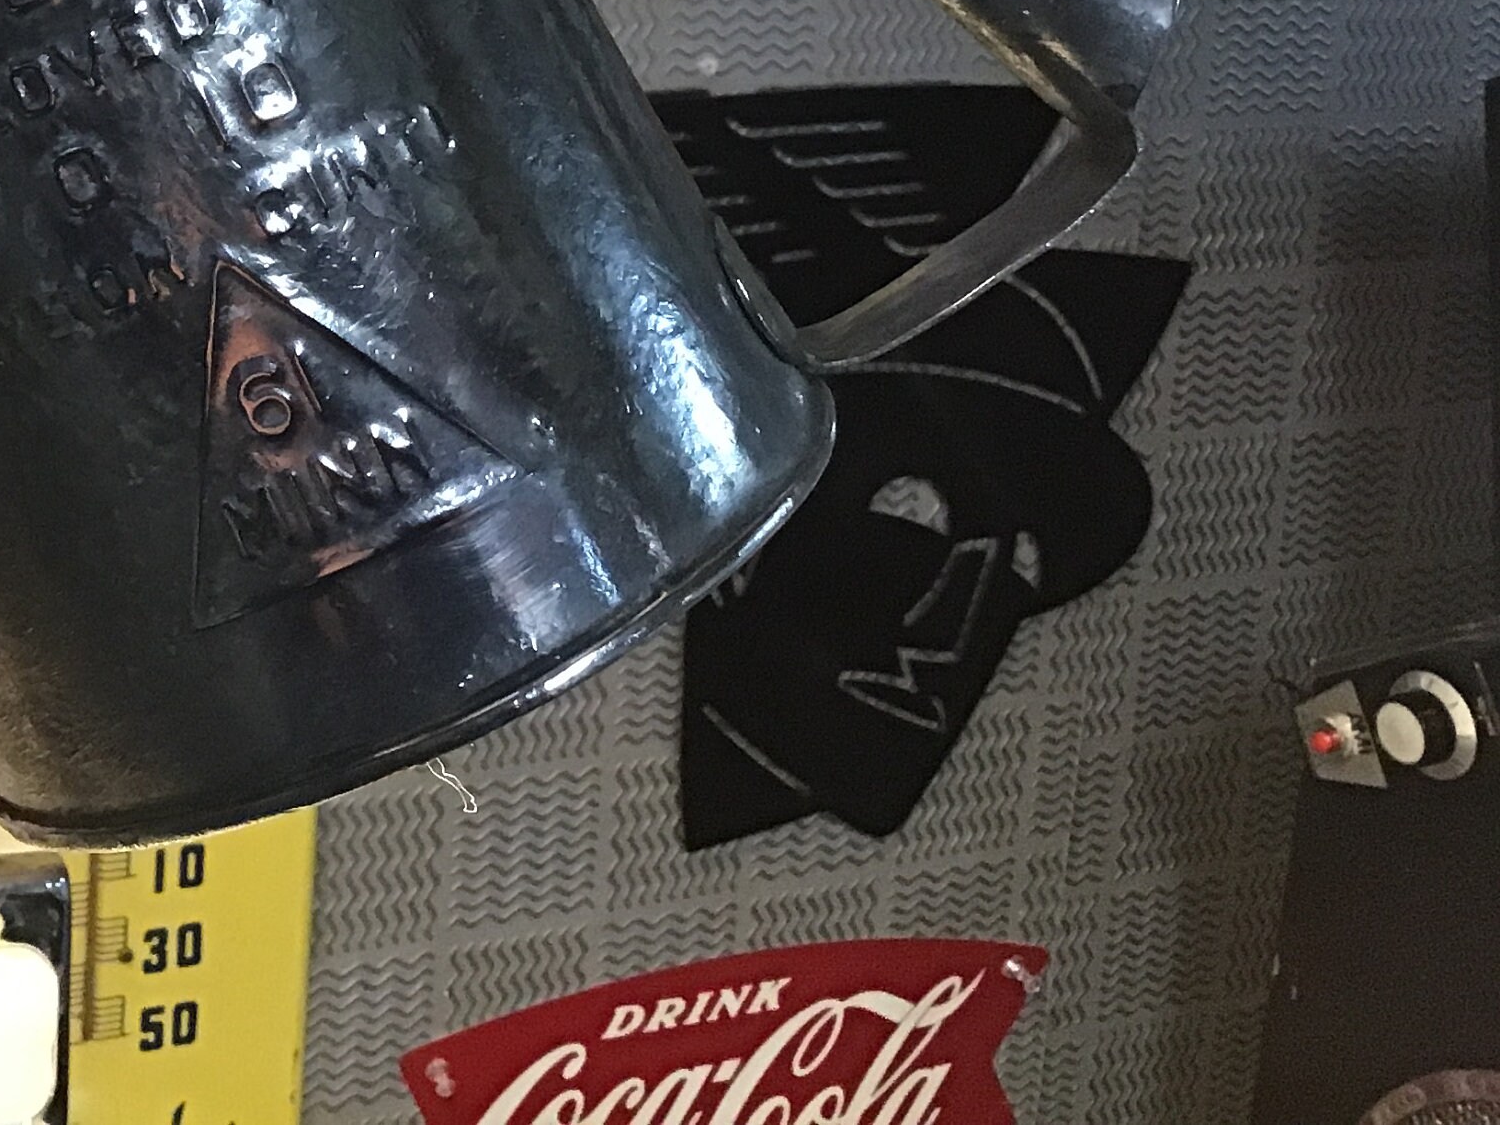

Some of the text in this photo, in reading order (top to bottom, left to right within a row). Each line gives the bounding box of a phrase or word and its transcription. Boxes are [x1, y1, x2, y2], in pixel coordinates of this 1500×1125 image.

[155, 844, 205, 894] 10
[143, 922, 203, 975] 30
[138, 1000, 199, 1052] 50
[601, 977, 792, 1040] DRINK
